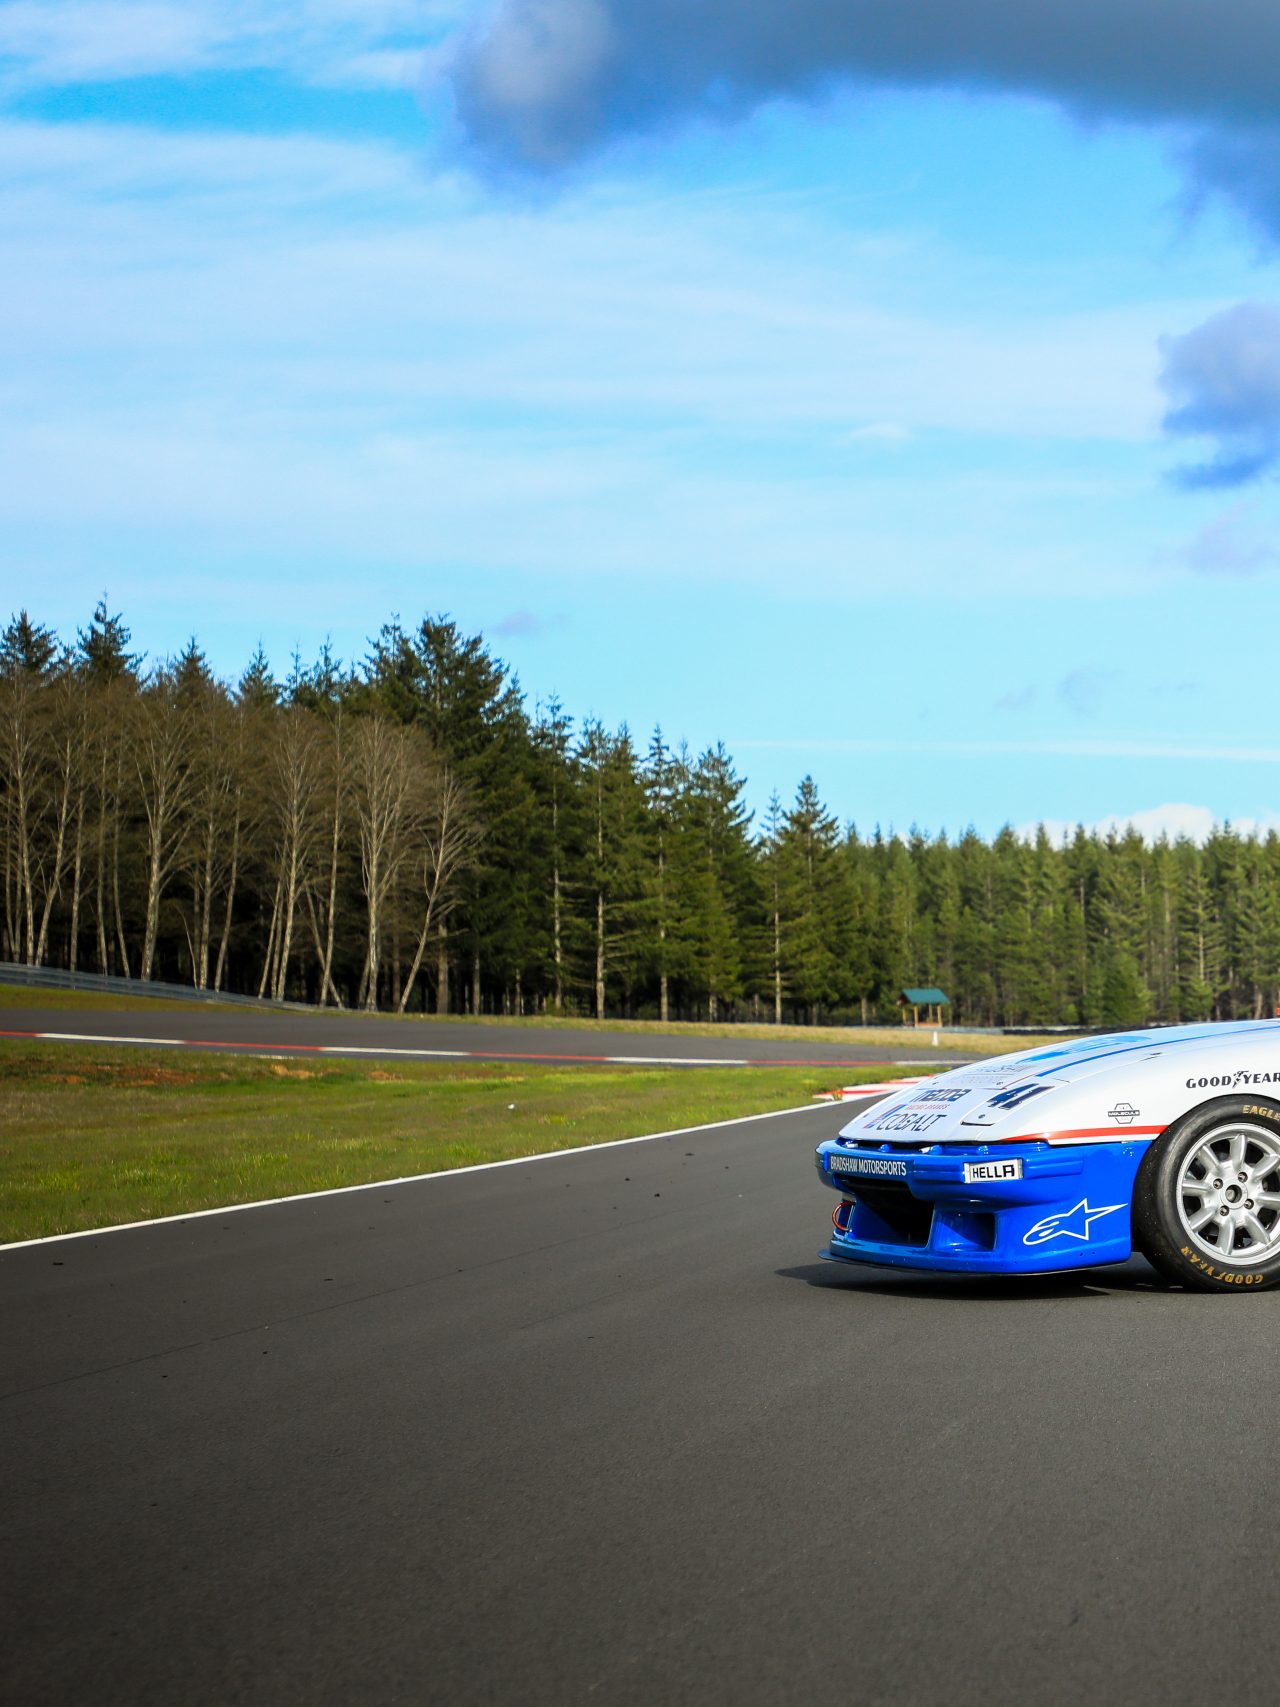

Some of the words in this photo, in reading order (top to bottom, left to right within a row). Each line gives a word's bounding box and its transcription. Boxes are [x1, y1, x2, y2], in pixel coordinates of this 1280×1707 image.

[876, 1113, 948, 1132] COBALT
[830, 1155, 858, 1171] BRADSHAW
[858, 1158, 907, 1177] MOTORSPORTS
[972, 1164, 1016, 1179] HELLA
